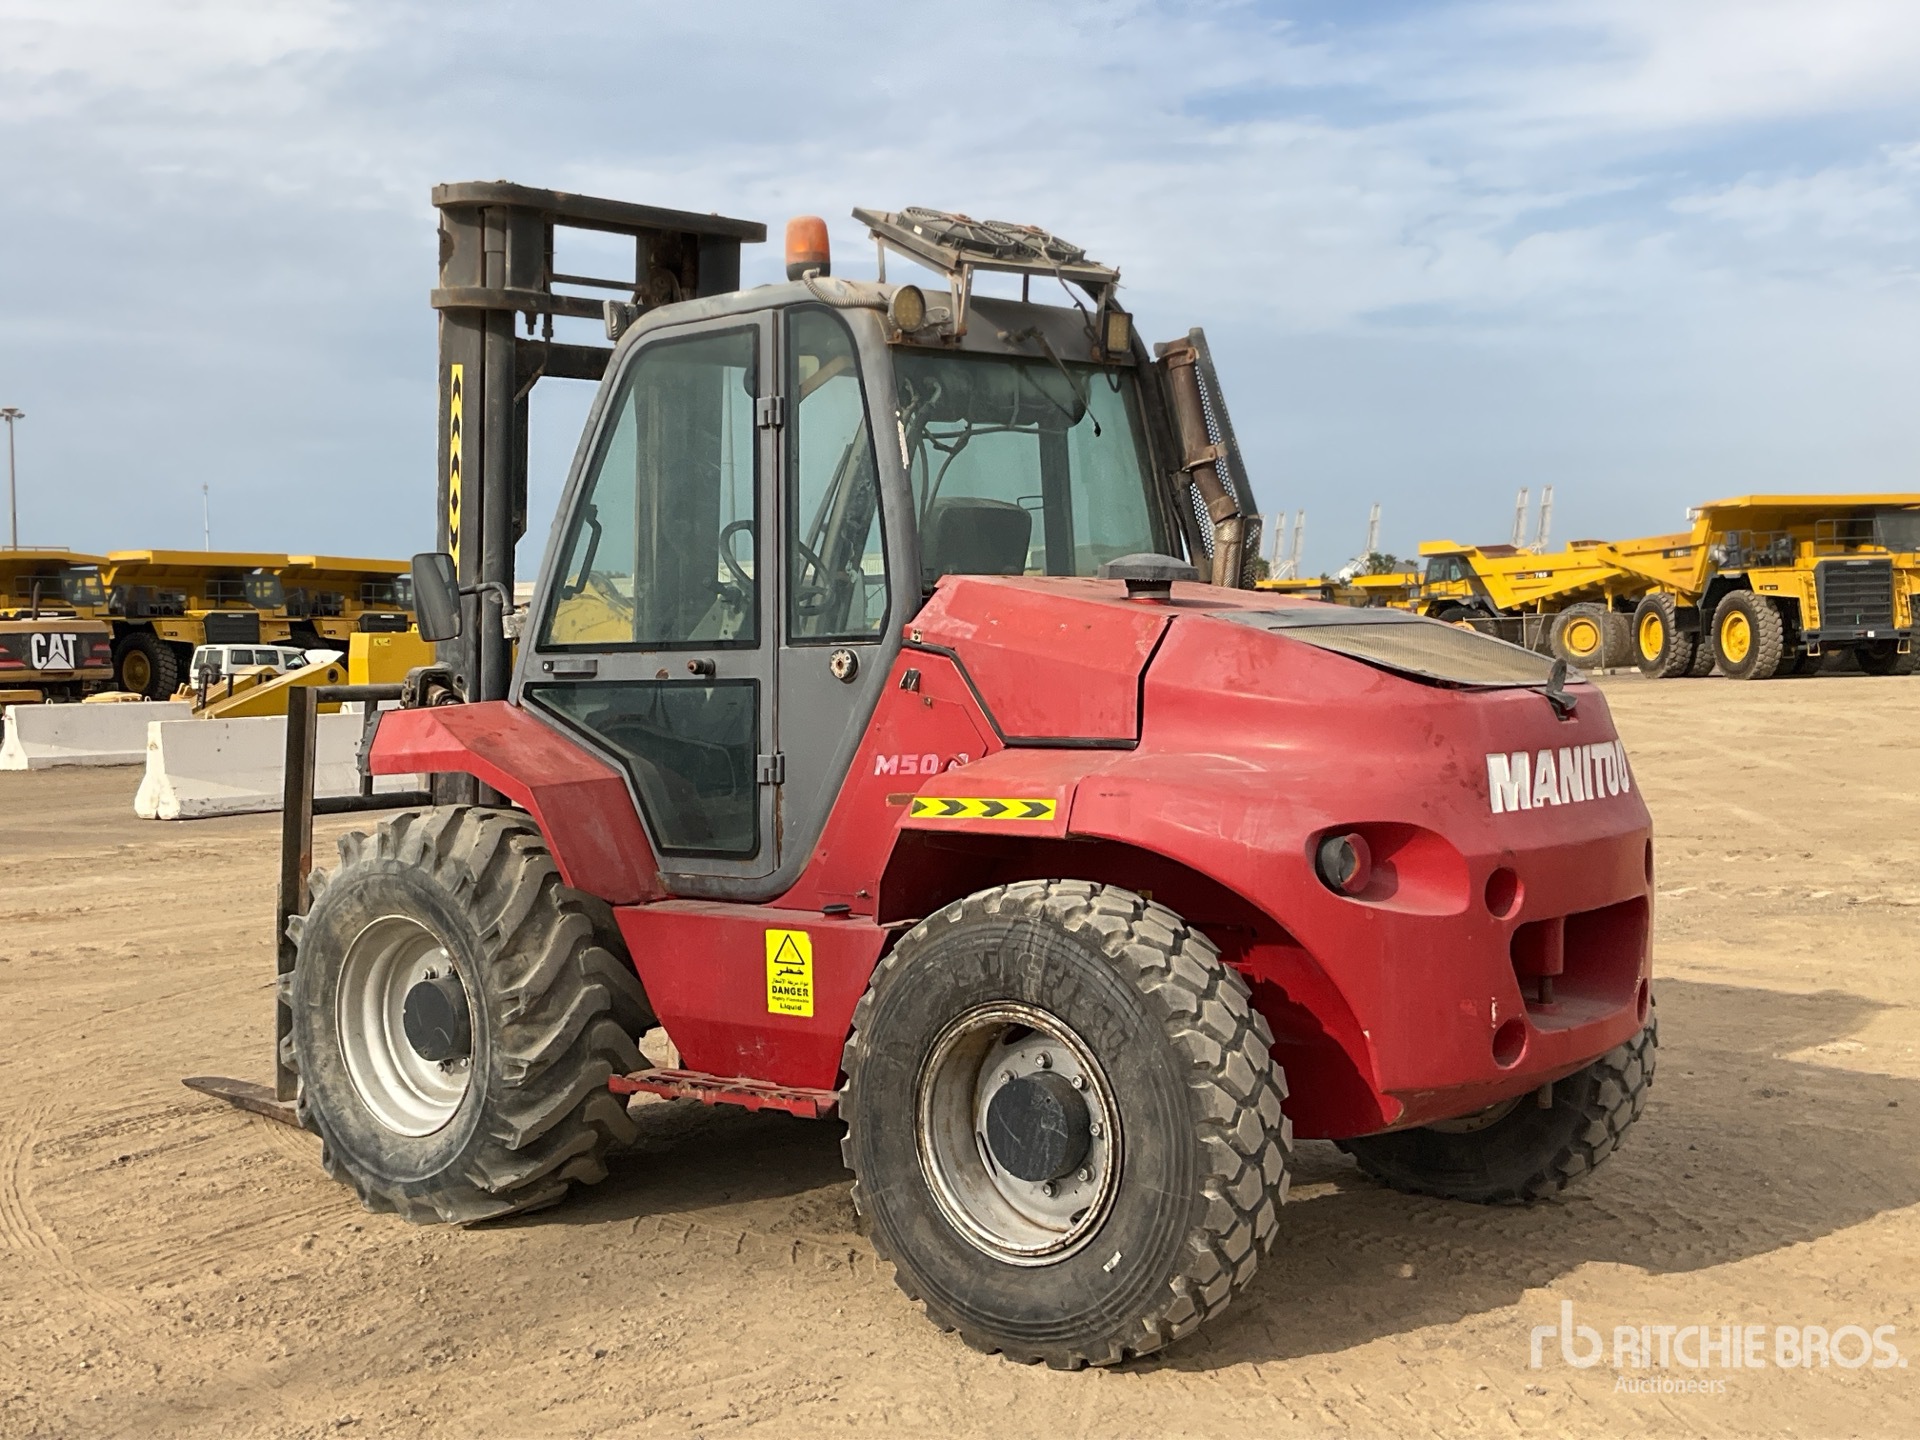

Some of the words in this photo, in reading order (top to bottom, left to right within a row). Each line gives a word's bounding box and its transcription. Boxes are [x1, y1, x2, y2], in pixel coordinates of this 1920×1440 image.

[30, 632, 77, 670] CAT
[1486, 738, 1630, 814] MANITOU
[771, 985, 809, 997] DANGER
